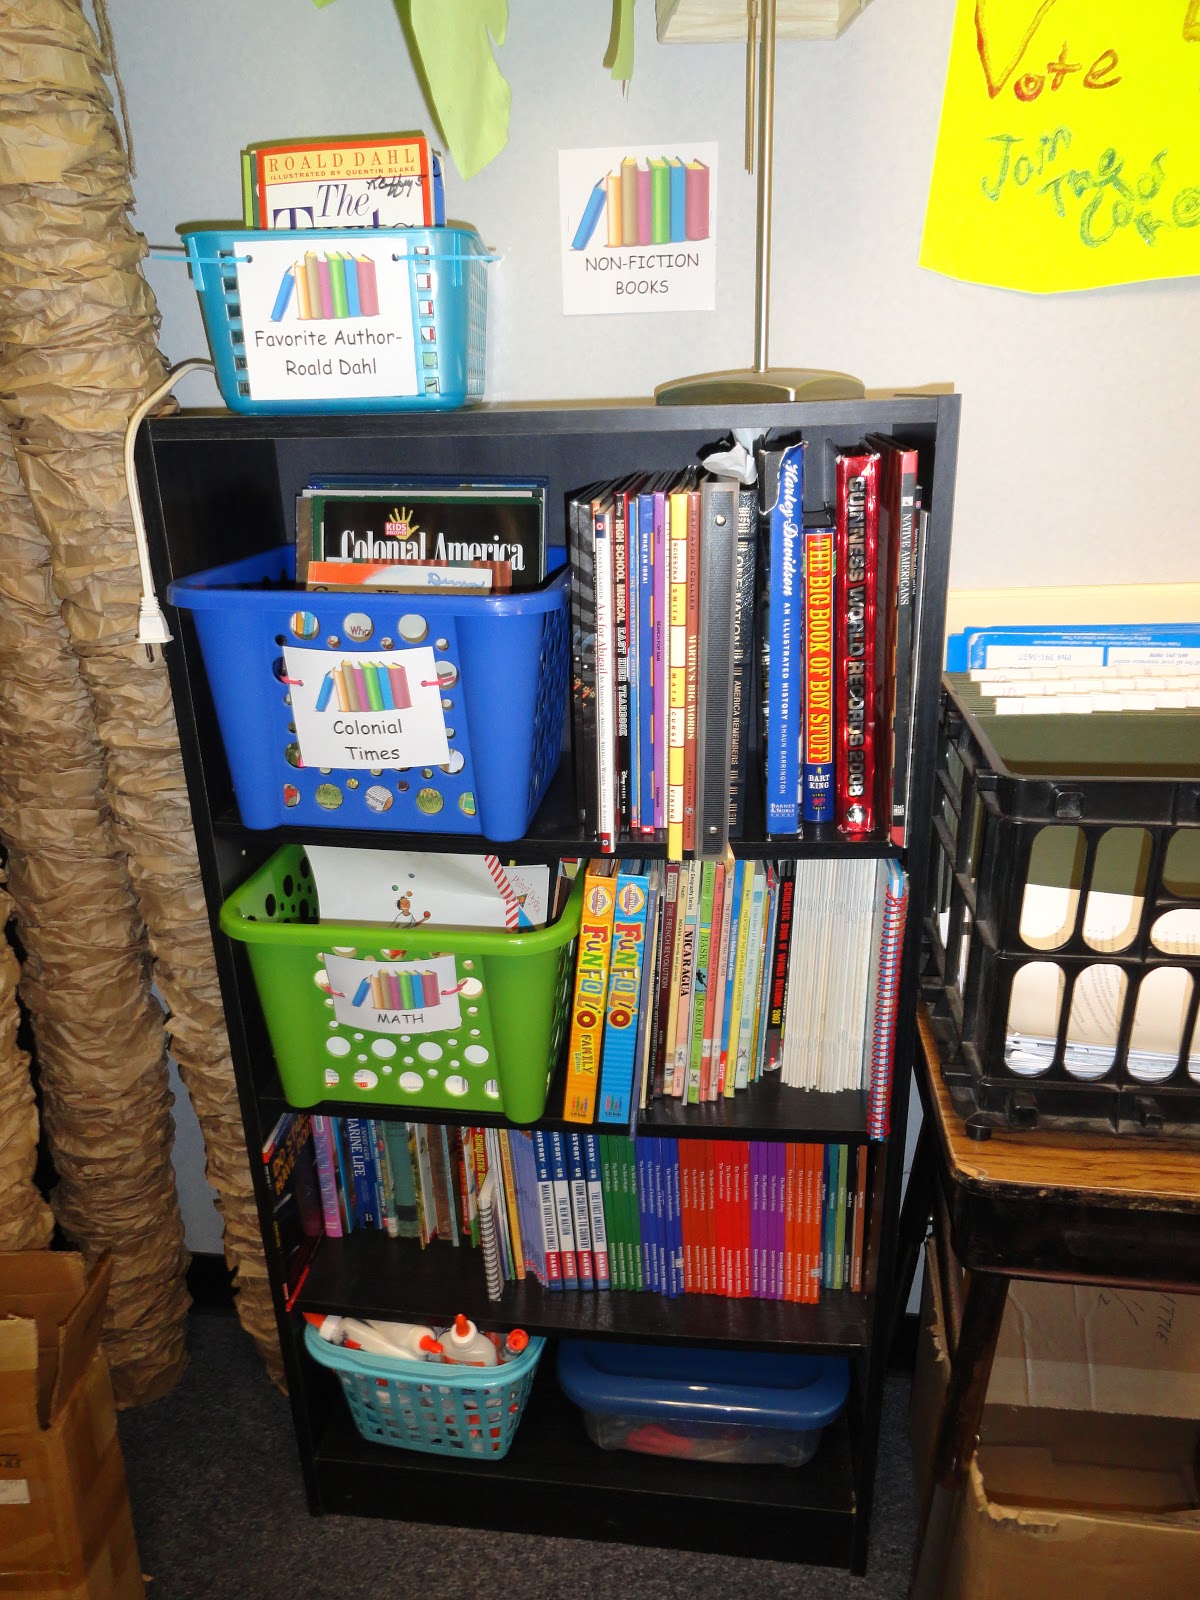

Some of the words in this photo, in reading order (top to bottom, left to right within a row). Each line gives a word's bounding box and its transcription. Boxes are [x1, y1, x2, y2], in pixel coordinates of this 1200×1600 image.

[269, 152, 344, 173] ROALD
[354, 148, 415, 167] DAHL
[270, 170, 326, 181] ILLUSTRATED
[346, 168, 384, 177] QUENTIN
[388, 166, 415, 174] BLAKE
[316, 183, 370, 218] The
[585, 253, 700, 272] NON-FICTION
[616, 280, 670, 295] BOOKS
[254, 330, 328, 349] Favorite
[333, 328, 403, 346] Author-
[285, 358, 333, 376] Roald
[339, 356, 377, 376] Dahl
[386, 522, 408, 532] KIDS
[615, 519, 625, 542] HIGH
[779, 459, 799, 597] Harley-Davidson
[848, 476, 867, 583] GUINNESS
[902, 513, 912, 548] NATIVE
[340, 530, 426, 562] Colonial
[434, 532, 526, 571] America
[642, 554, 648, 564] AN
[808, 537, 831, 573] THE
[615, 544, 625, 582] SCHOOL
[900, 550, 911, 605] AMERICANS
[808, 574, 831, 606] BIG
[616, 584, 626, 623] MUSICAL
[782, 602, 791, 615] AN
[598, 612, 607, 621] is
[734, 592, 743, 645] NATION
[848, 585, 866, 657] WORLD
[598, 624, 608, 638] for
[617, 627, 626, 654] EAST
[808, 607, 831, 654] BOOK
[597, 641, 608, 674] Abigail
[688, 634, 697, 682] MARTIN'S
[781, 618, 791, 679] ILLUSTRATED
[618, 657, 627, 682] HIGH
[808, 657, 830, 677] OF
[687, 684, 696, 702] BIG
[733, 680, 741, 715] AMERICA
[780, 682, 789, 720] HISTORY
[809, 680, 831, 711] BOY
[848, 660, 865, 747] RECORDS
[618, 685, 628, 737] YEARBOOK
[686, 703, 696, 740] WORDS
[333, 719, 403, 736] Colonial
[808, 713, 830, 763] STUFF
[731, 717, 740, 765] REMEMBERS
[344, 746, 401, 761] Times
[779, 750, 787, 794] BARRINGTON
[808, 774, 831, 783] BART
[848, 750, 865, 797] 2008
[809, 781, 830, 789] KING
[666, 904, 674, 917] THE
[782, 881, 793, 921] SCHOLASTIC
[664, 918, 673, 945] FRENCH
[779, 923, 789, 941] BOOK
[662, 945, 671, 989] REVOLUTION
[680, 930, 694, 997] NICARAGUA
[775, 953, 787, 977] WORLD
[698, 997, 705, 1006] IS
[773, 979, 784, 1007] RECORDS
[377, 1013, 424, 1024] MATH
[695, 1009, 704, 1026] FOR
[771, 1009, 781, 1024] 2007
[580, 1034, 593, 1075] FAMILY
[474, 1134, 485, 1171] SCHOLASTIC
[352, 1155, 366, 1177] LIFE
[540, 1169, 547, 1179] US
[557, 1168, 564, 1178] US
[575, 1167, 582, 1177] US
[590, 1169, 597, 1179] US
[541, 1184, 550, 1204] MAKING
[575, 1182, 586, 1196] FROM
[590, 1191, 601, 1201] THE
[558, 1197, 567, 1207] THE
[560, 1207, 569, 1217] NEW
[576, 1197, 587, 1220] COLONIES
[592, 1202, 602, 1215] FIRST
[543, 1204, 554, 1227] THIRTEEN
[561, 1218, 571, 1236] NATION
[546, 1227, 557, 1250] COLONIES
[579, 1228, 591, 1249] COUNTRY
[593, 1216, 604, 1243] AMERICANS
[566, 1253, 574, 1276] HAKIM
[582, 1253, 590, 1276] HAKIM
